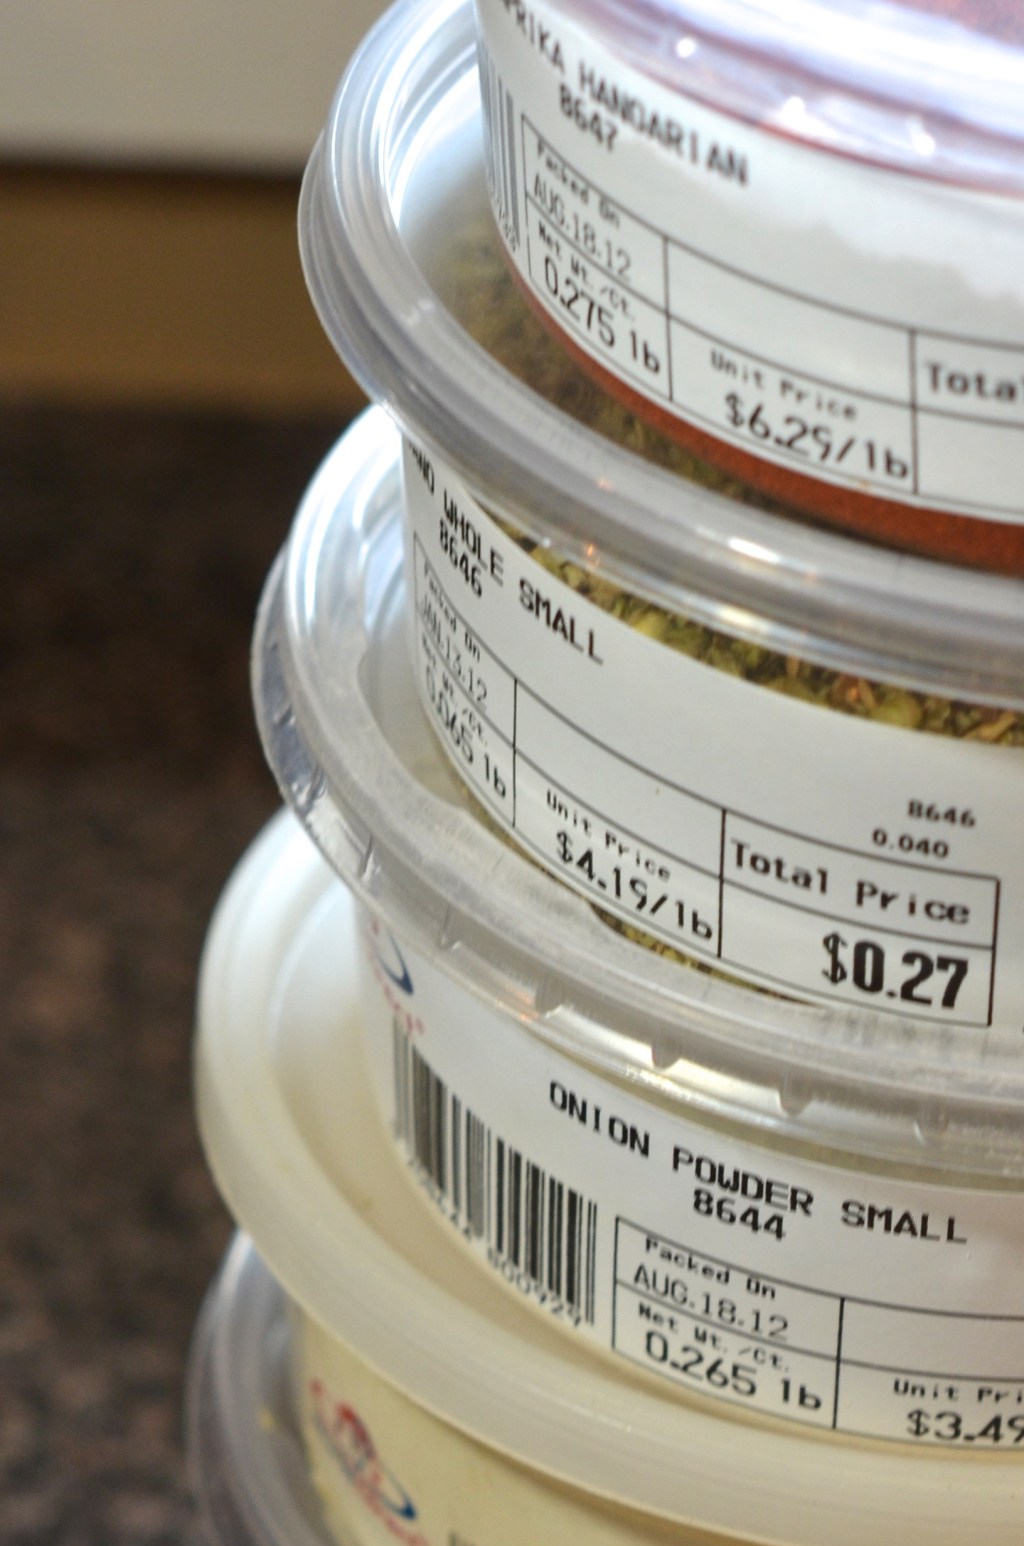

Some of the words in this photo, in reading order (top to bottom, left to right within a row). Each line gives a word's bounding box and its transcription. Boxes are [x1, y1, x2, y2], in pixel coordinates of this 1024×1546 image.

[559, 82, 618, 153] 8647
[536, 138, 590, 203] Packed
[599, 199, 621, 230] On
[533, 173, 632, 282] AUG.18.12
[538, 220, 562, 260] Net
[544, 255, 616, 349] 0.275
[711, 350, 764, 390] Unit
[780, 378, 857, 418] Price
[725, 392, 908, 478] $6.29/lb
[439, 517, 482, 599] 8646
[444, 488, 504, 588] WHOLE
[519, 577, 604, 667] SMALL
[547, 788, 592, 837] Unit
[605, 830, 672, 884] Price
[871, 827, 950, 859] 0.040
[907, 799, 976, 829] 8646
[556, 830, 713, 940] $4.19/lb
[730, 837, 829, 896] Total
[856, 879, 971, 925] Price
[821, 931, 969, 1011] $0.27
[548, 1079, 651, 1158] ONION
[672, 1143, 815, 1218] POWDER
[841, 1199, 968, 1245] SMALL
[692, 1187, 787, 1241] 8644
[633, 1262, 789, 1342] AUG.18.12
[644, 1235, 731, 1285] Packed
[745, 1276, 777, 1301] On
[638, 1301, 678, 1335] Net
[645, 1328, 757, 1398] 0.265
[780, 1377, 823, 1411] lb
[893, 1378, 960, 1402] Unit
